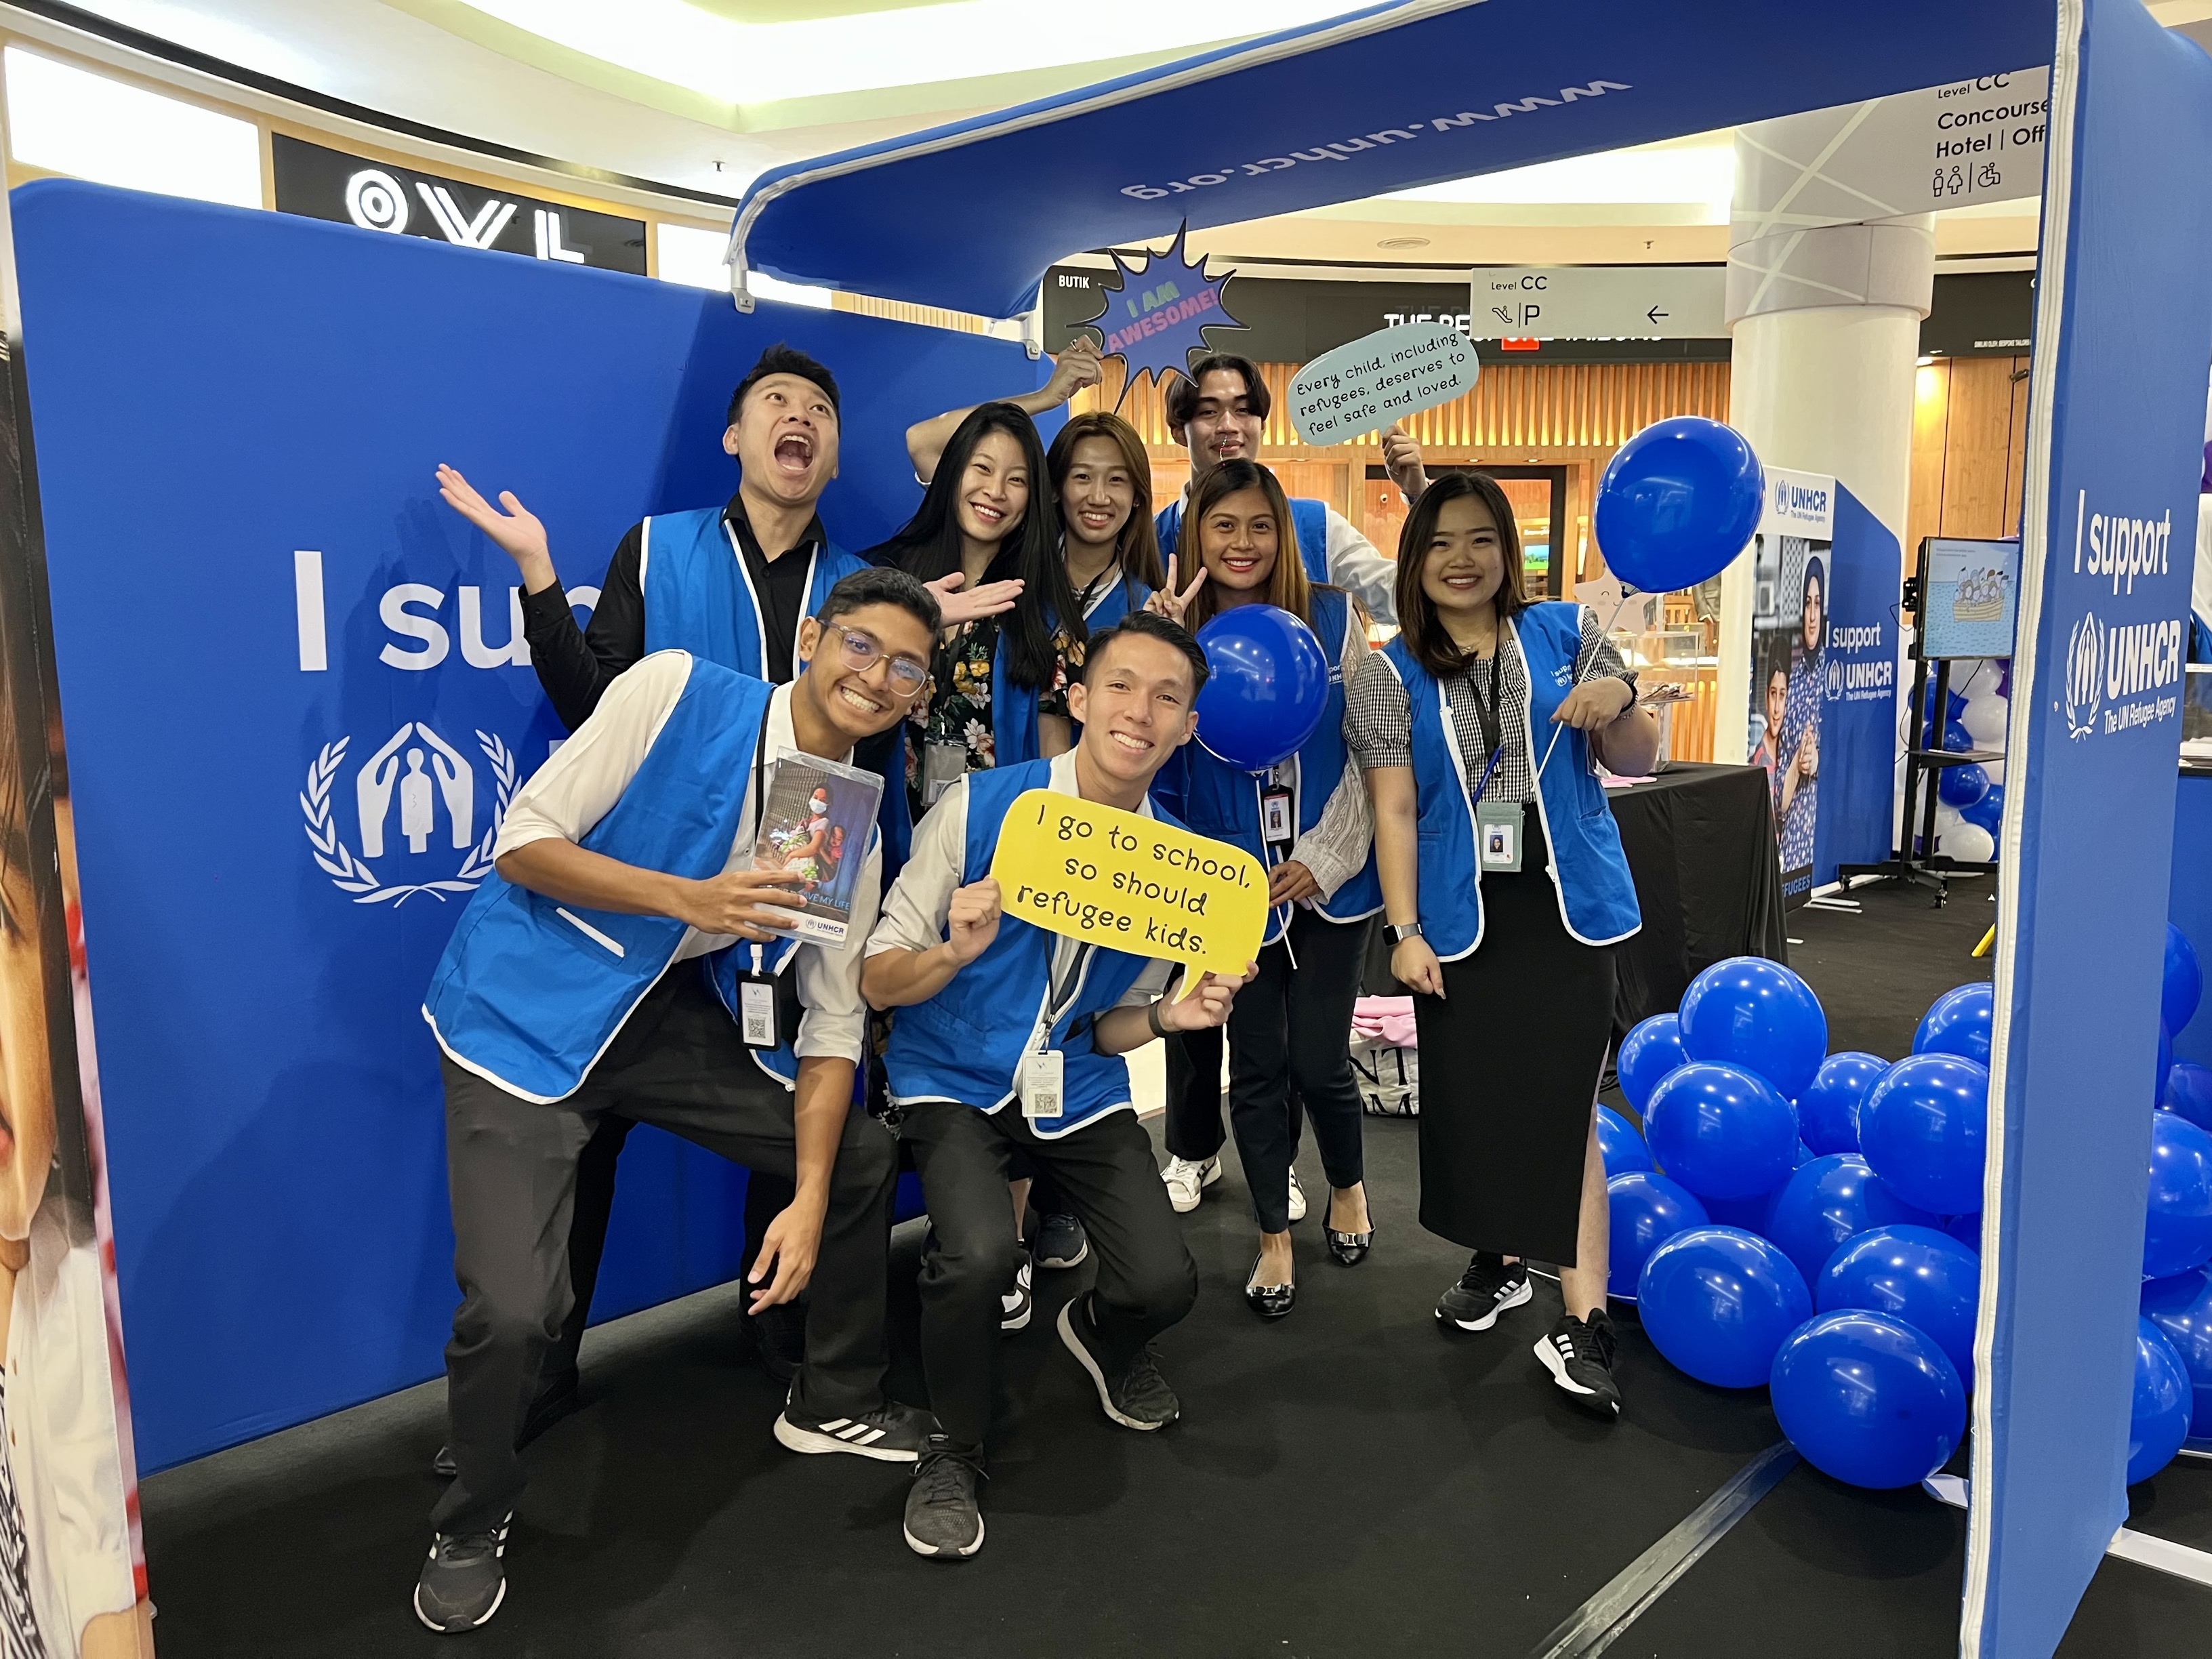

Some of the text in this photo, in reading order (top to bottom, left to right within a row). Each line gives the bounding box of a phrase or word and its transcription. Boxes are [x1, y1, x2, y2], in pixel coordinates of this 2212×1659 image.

[1938, 73, 2011, 99] Level CC
[1120, 80, 1634, 201] www.unhcr.org
[1936, 133, 1992, 159] Hotel
[1059, 274, 1090, 289] BUTIK
[1126, 281, 1181, 319] I AM
[1491, 276, 1547, 291] Level CC
[1107, 287, 1221, 353] AWESOME!
[1524, 305, 1540, 326] P
[1296, 373, 1341, 396] Every
[1391, 333, 1459, 364] including
[1300, 353, 1465, 417] refugees, deserves to
[1309, 374, 1462, 436] feel safe and loved.
[1791, 486, 1826, 512] UNHCR
[2074, 489, 2171, 595] I support
[294, 550, 603, 672] I su
[1825, 620, 1881, 655] I support
[2106, 619, 2182, 701] UNHCR
[1845, 661, 1893, 690] UNHCR
[2104, 695, 2177, 735] The UN Refugee Agency
[1037, 804, 1250, 889] I go to school,
[1065, 857, 1208, 916] so should
[817, 922, 844, 935] UNHCR
[1017, 885, 1207, 955] refugee kids.
